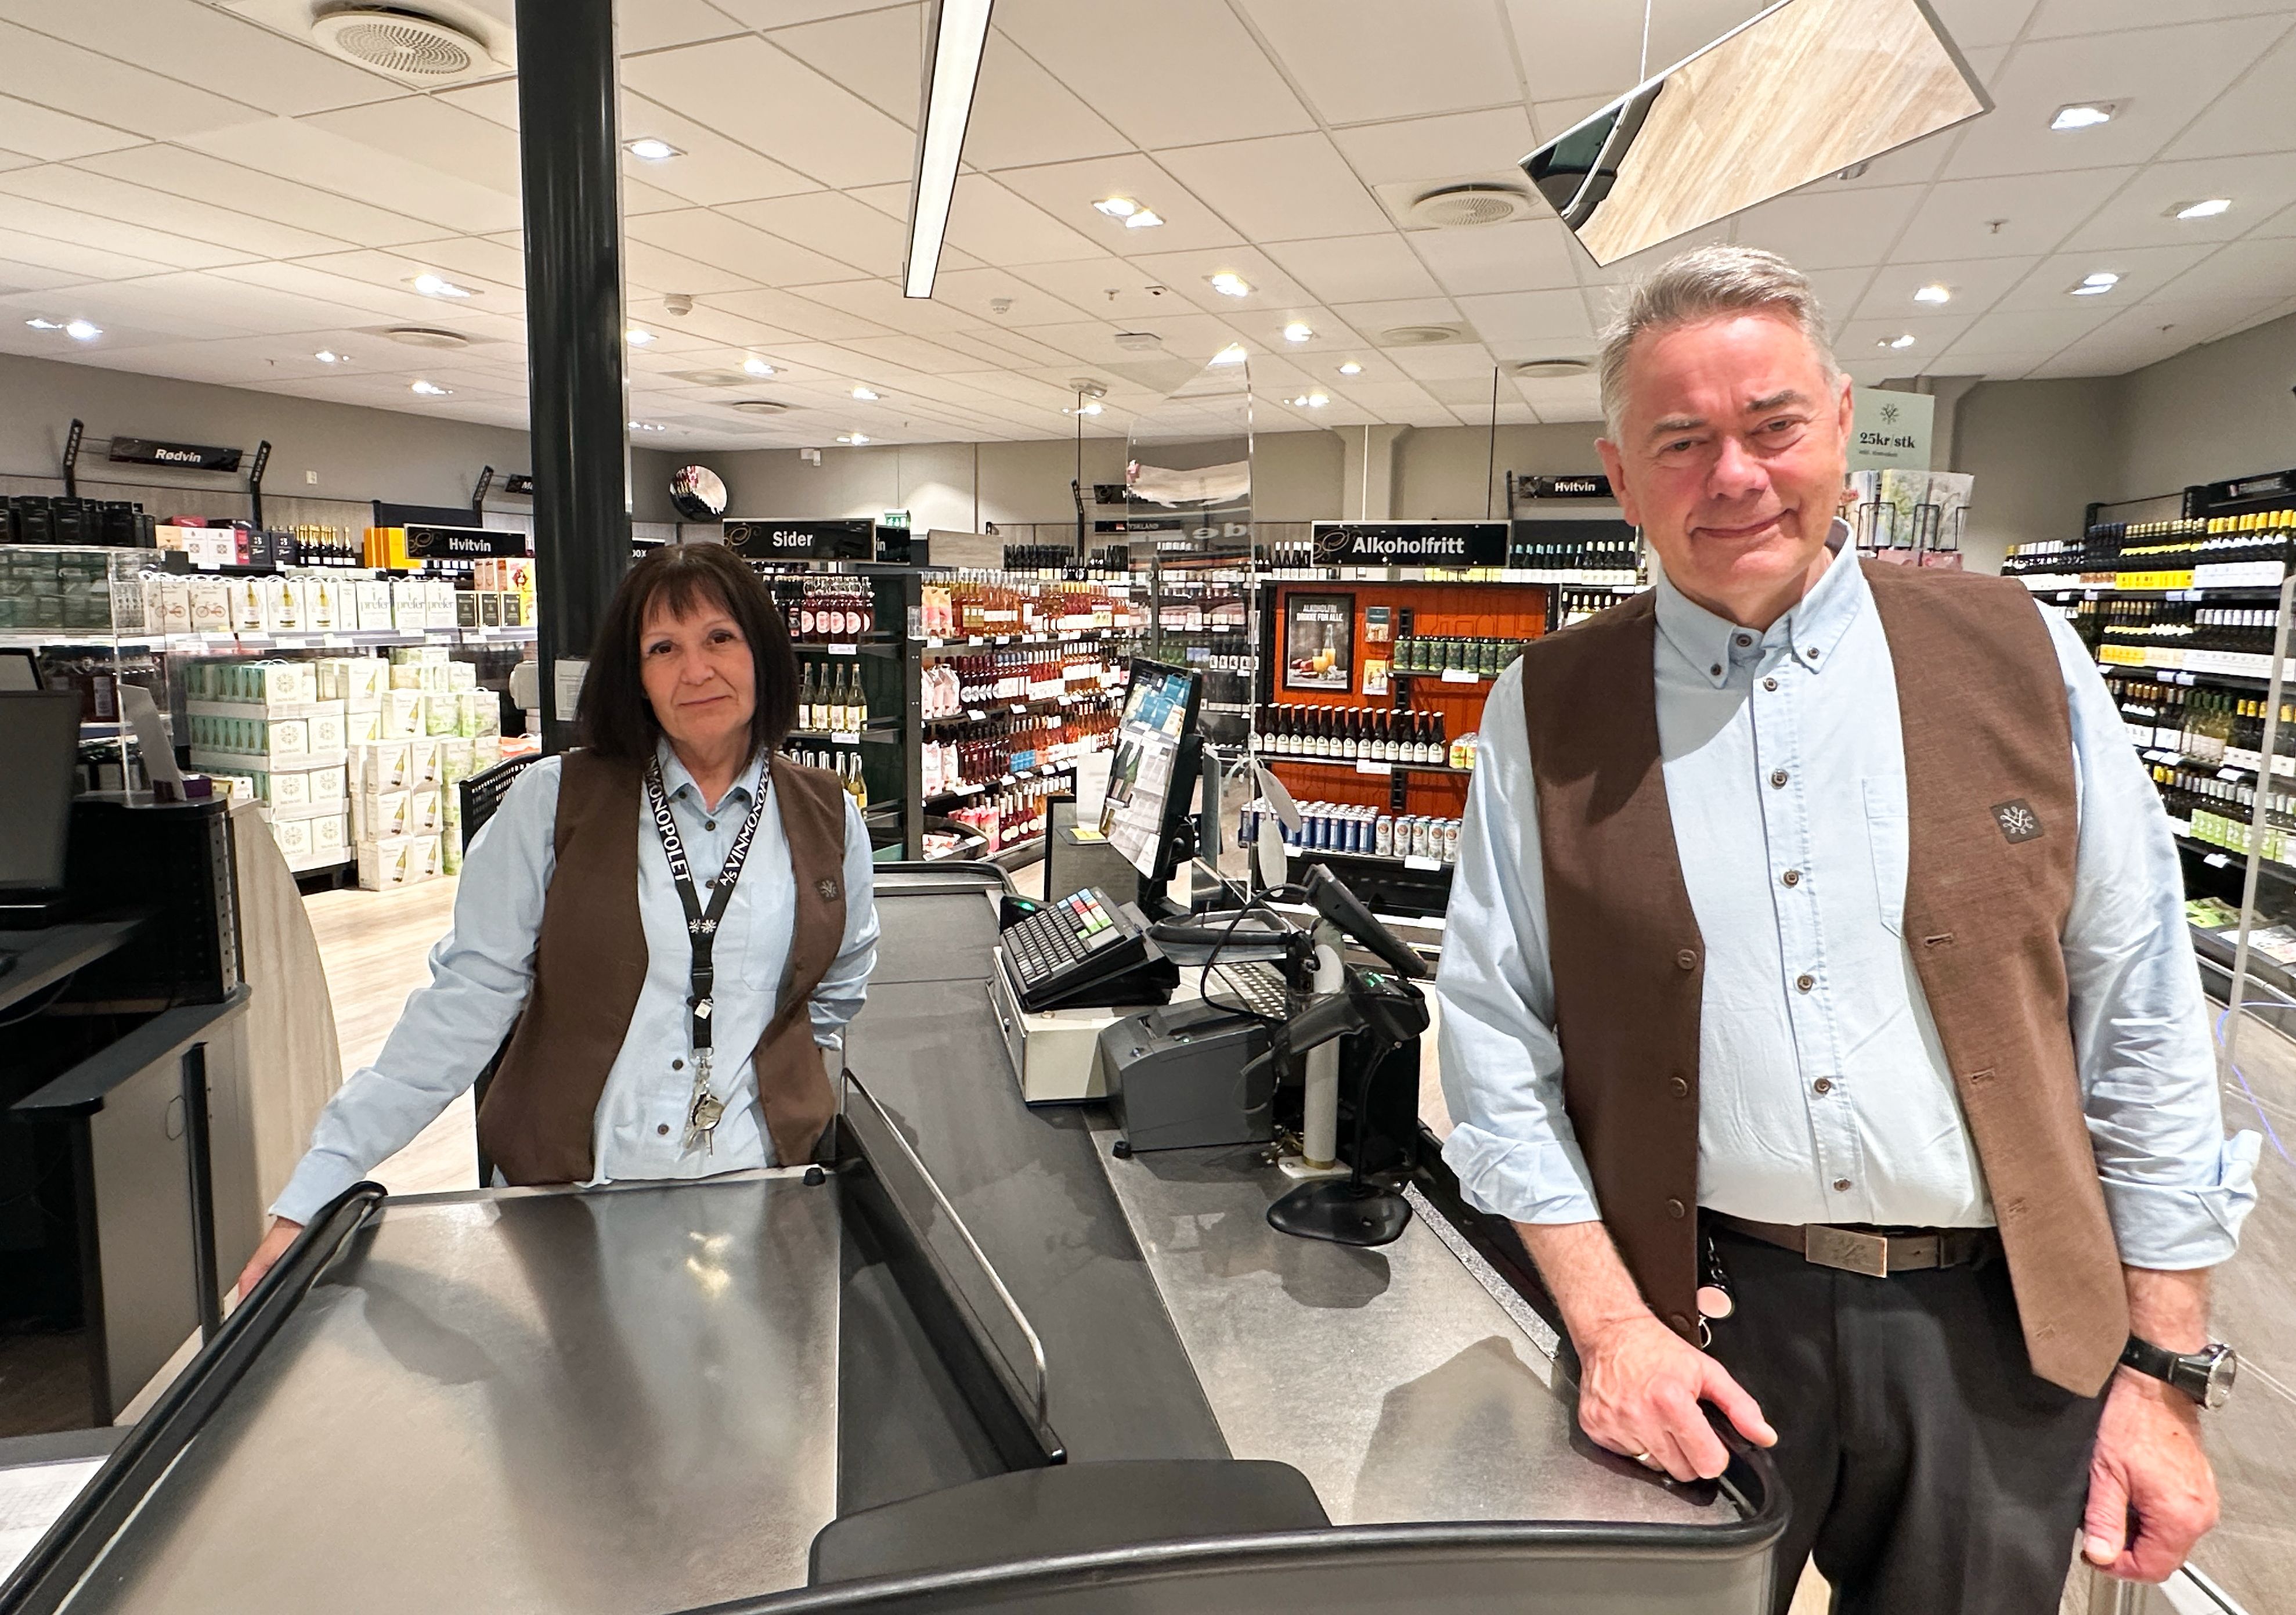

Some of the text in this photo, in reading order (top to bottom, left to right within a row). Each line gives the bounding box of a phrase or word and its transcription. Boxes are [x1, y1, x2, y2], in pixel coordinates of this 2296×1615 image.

[1555, 482, 1595, 492] Hvitvin
[449, 538, 492, 552] Hvitvin
[772, 531, 813, 547] Sider
[1352, 536, 1465, 554] Alkoholfritt
